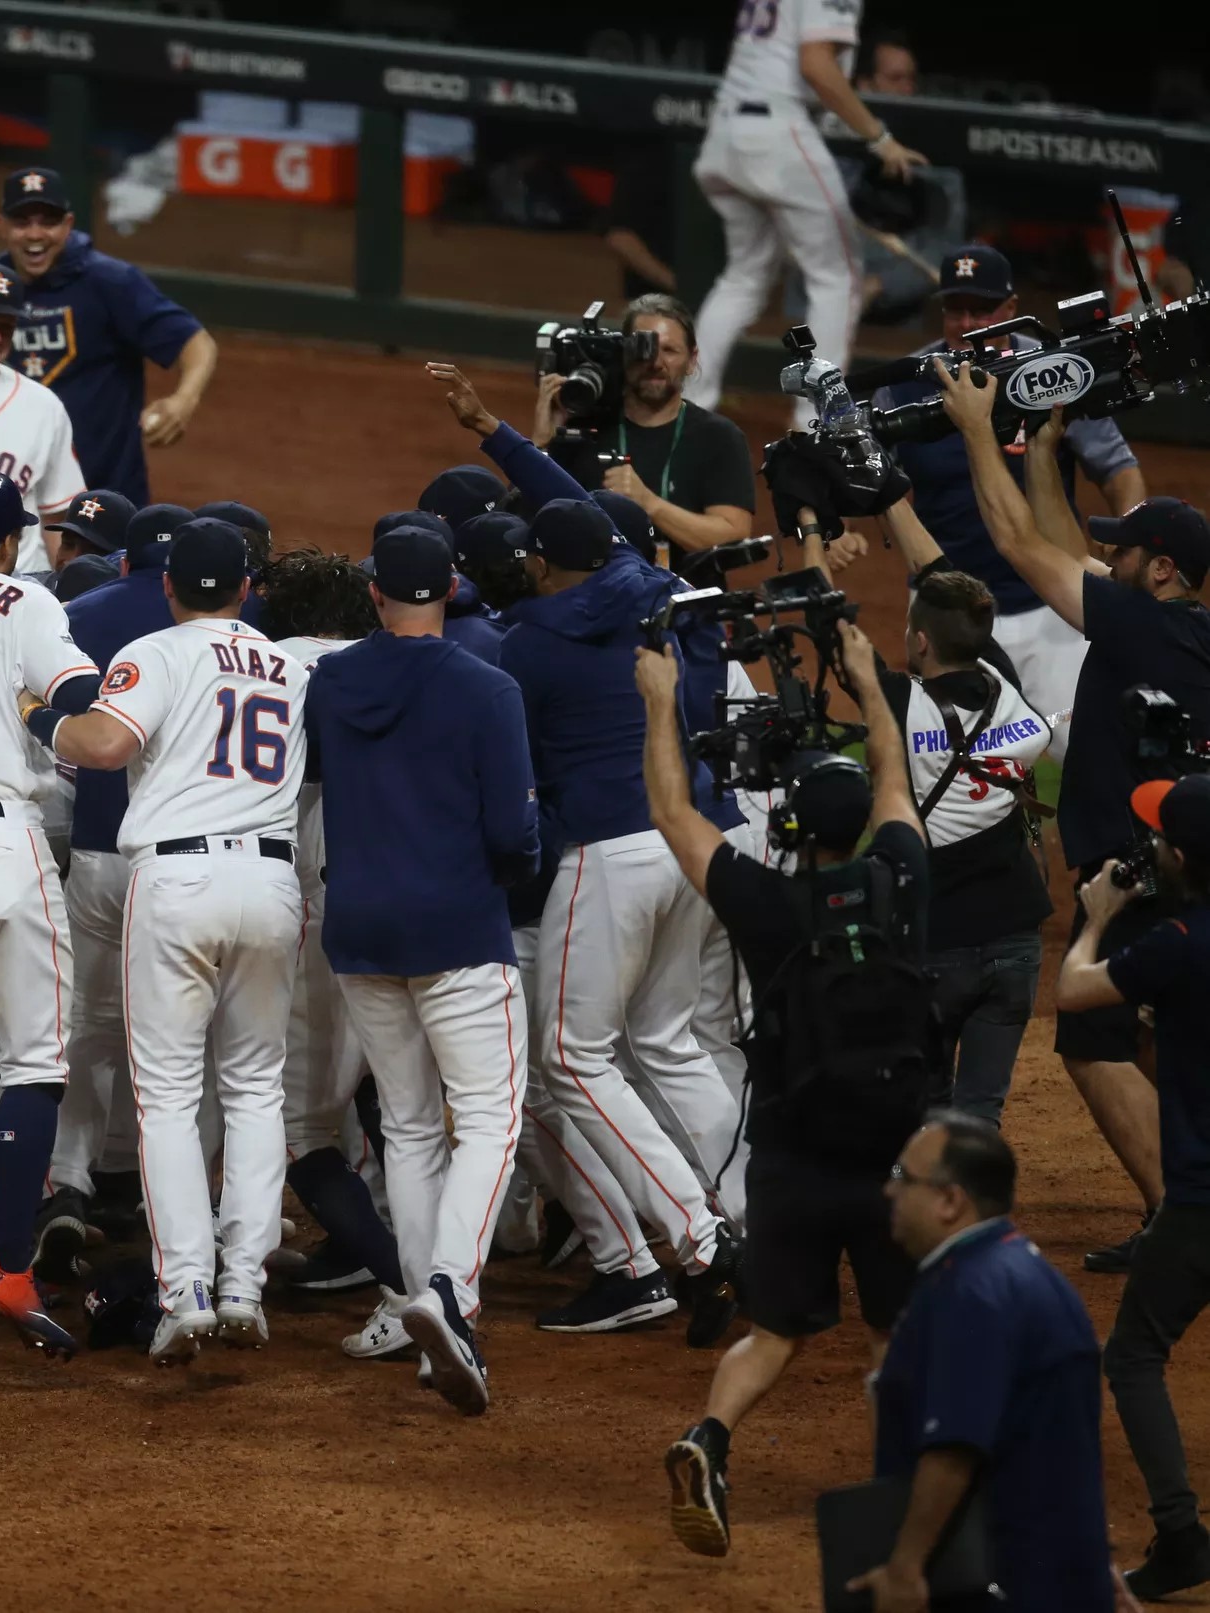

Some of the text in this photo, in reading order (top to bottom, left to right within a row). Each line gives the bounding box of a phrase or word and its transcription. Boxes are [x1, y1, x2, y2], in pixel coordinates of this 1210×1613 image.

[196, 137, 242, 188] G
[273, 144, 314, 194] G
[1023, 362, 1075, 395] FOX
[1029, 382, 1079, 402] SPORTS
[210, 638, 287, 687] DÍAZ
[206, 686, 290, 786] 16
[913, 718, 1041, 754] PHORAPHER
